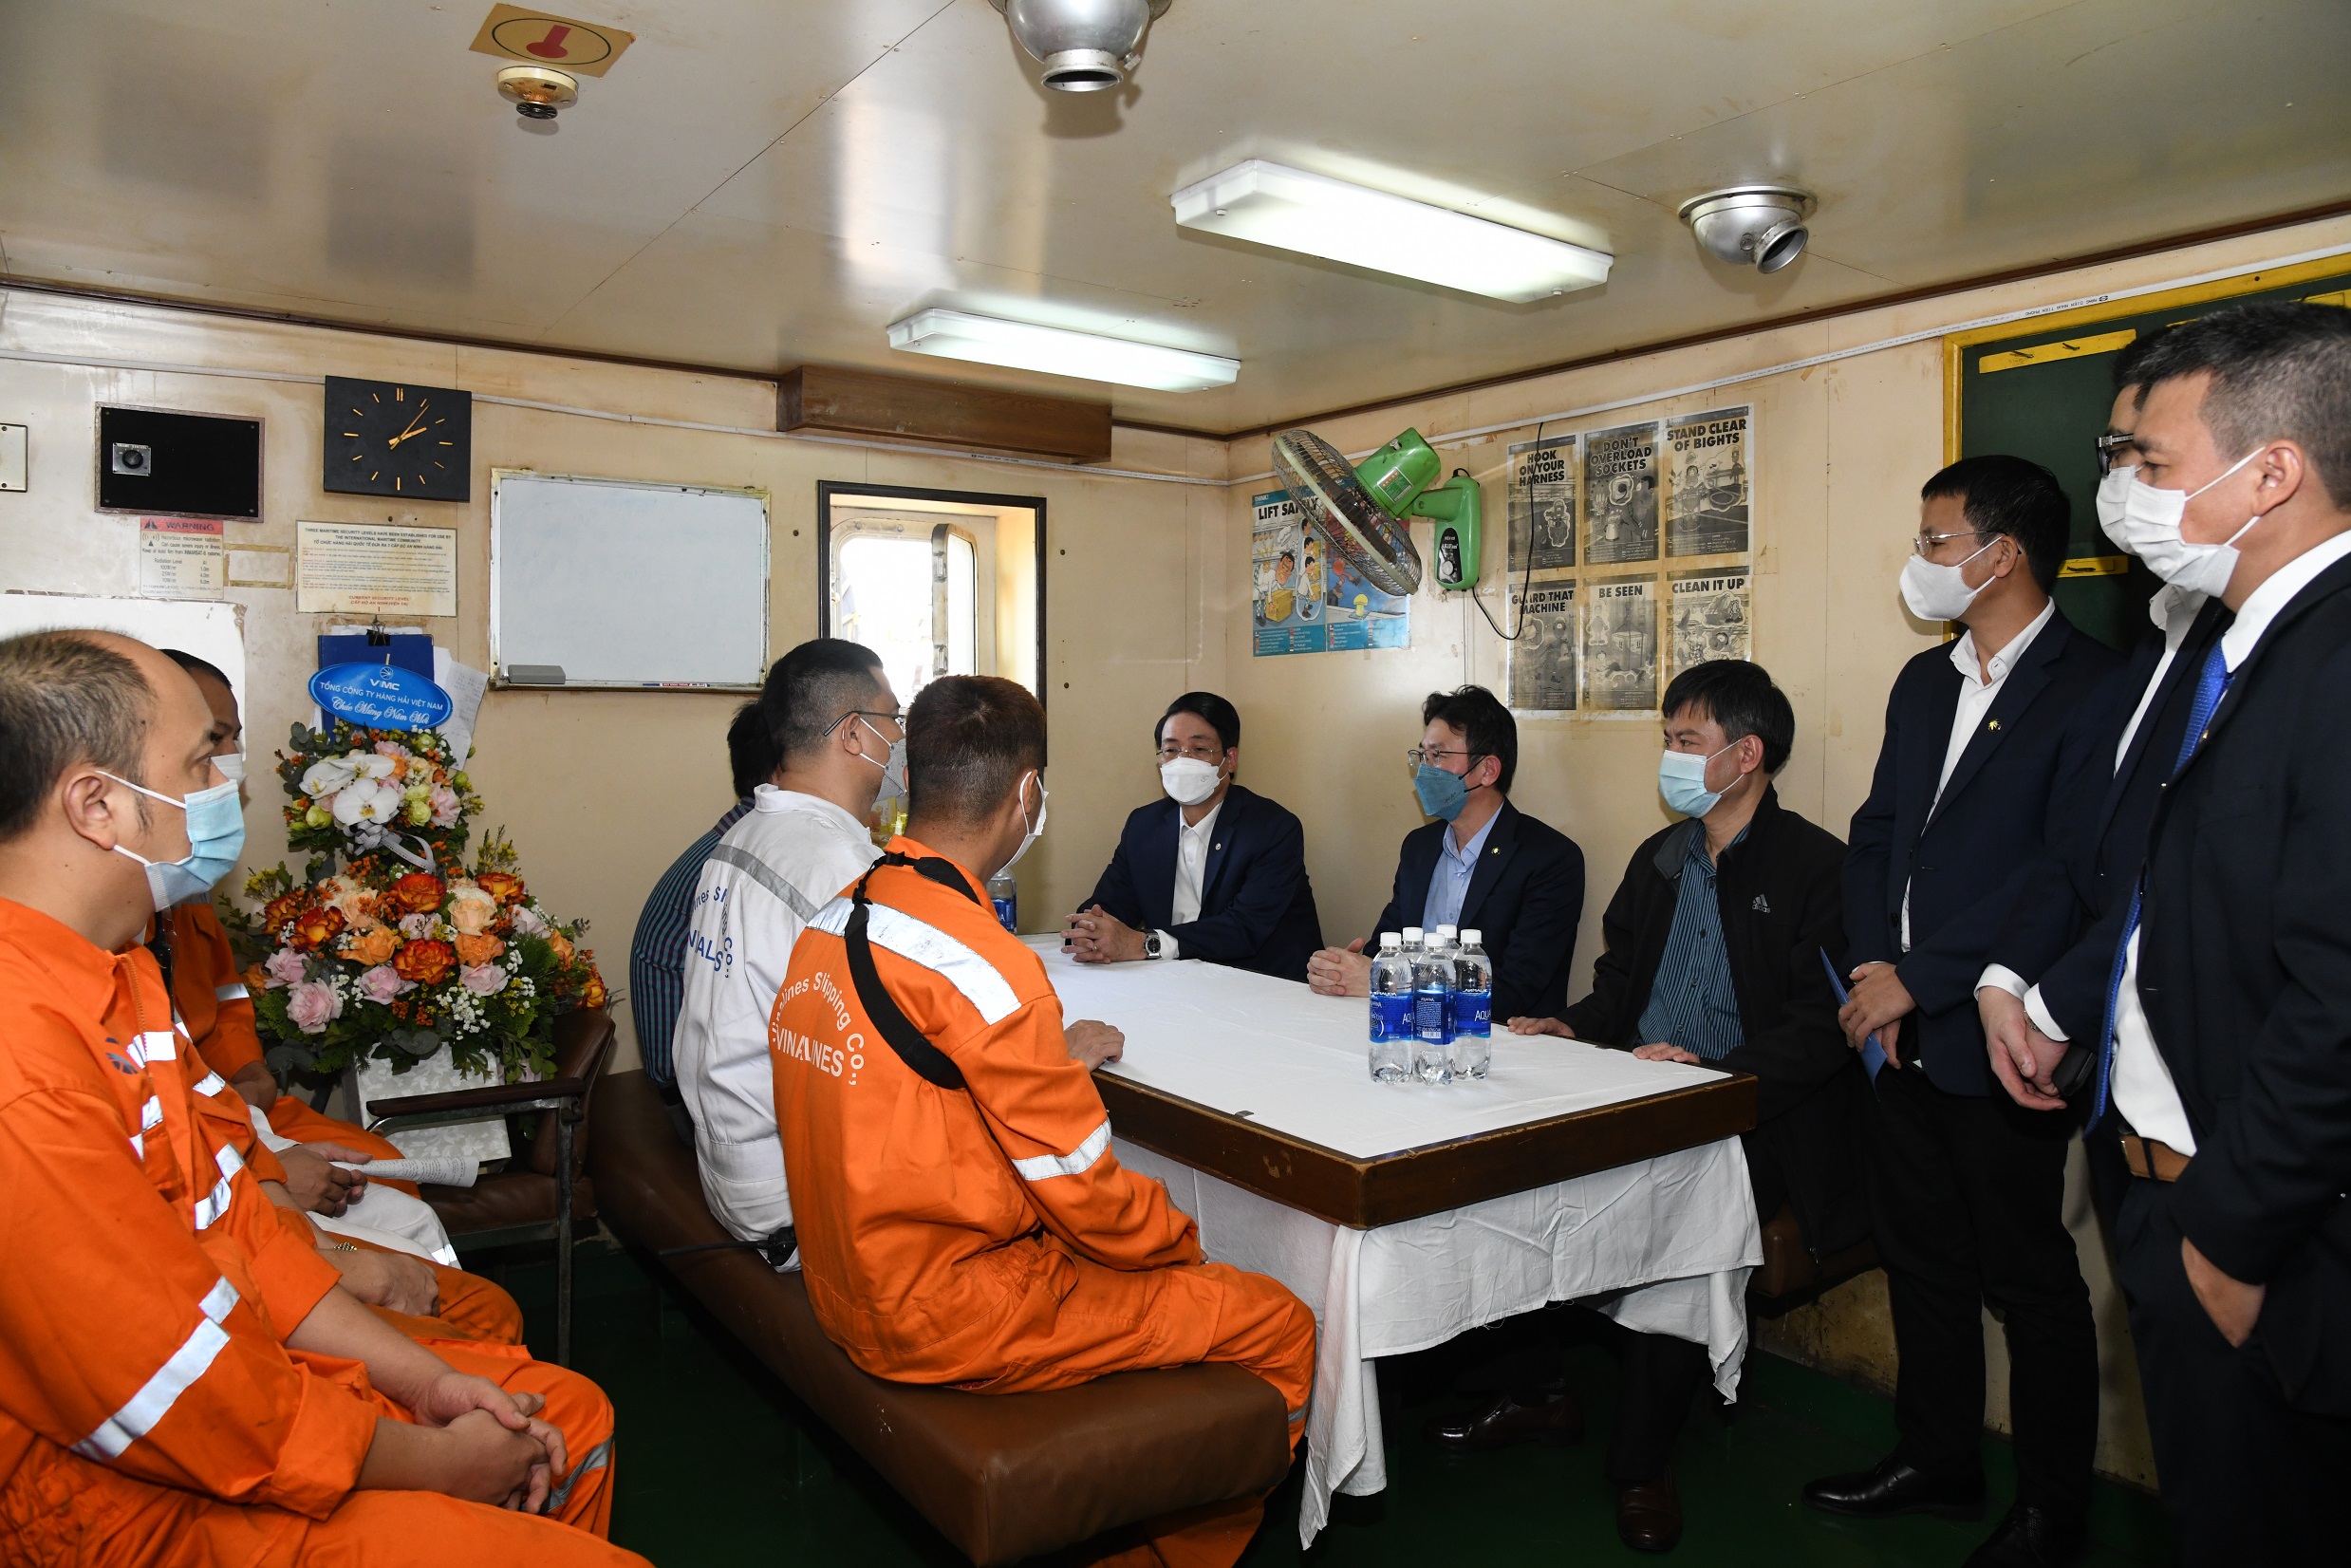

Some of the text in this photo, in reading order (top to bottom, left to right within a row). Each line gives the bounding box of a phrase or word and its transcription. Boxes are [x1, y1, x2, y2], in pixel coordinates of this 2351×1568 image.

[1667, 419, 1746, 441] STAND CLEAR
[1603, 437, 1638, 452] DON'T
[1674, 432, 1740, 452] OF BIGHTS
[1527, 450, 1557, 463] HOOK
[1590, 447, 1652, 466] OVERLOAD
[1519, 460, 1564, 476] ON YOUR
[1595, 458, 1646, 477] SOCKETS
[1519, 471, 1564, 486] HARNESS
[1259, 506, 1278, 520] LIFT
[166, 521, 214, 531] WARNING
[1599, 585, 1643, 598] BE SEEN
[1672, 578, 1745, 594] CLEAN IT UP
[1549, 590, 1574, 601] THAT
[1519, 602, 1566, 615] MACHINE
[320, 681, 340, 692] TỔNG
[342, 686, 364, 696] CÔNG
[376, 692, 396, 702] HÀNG
[397, 695, 410, 705] HẢI
[411, 698, 426, 707] VIỆT
[427, 702, 443, 711] NAM
[332, 696, 353, 711] Chúc
[1752, 903, 1771, 913] adidas
